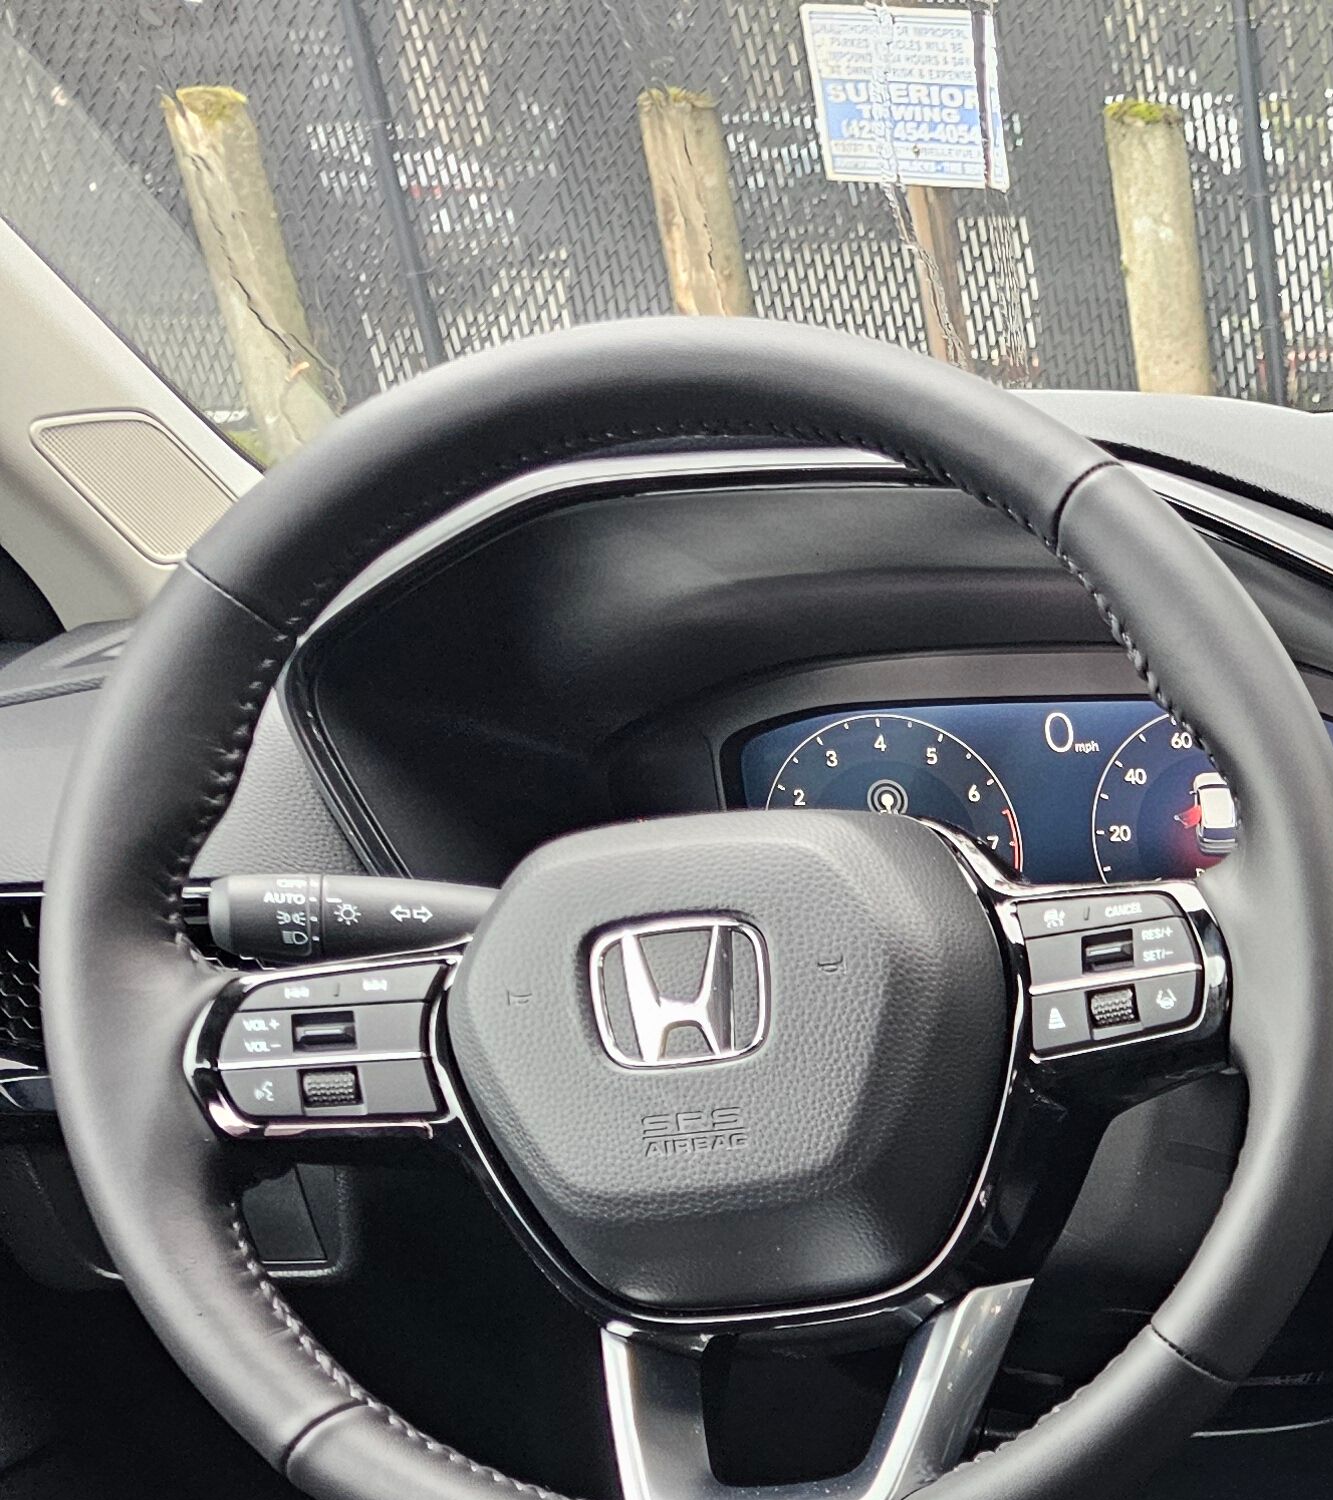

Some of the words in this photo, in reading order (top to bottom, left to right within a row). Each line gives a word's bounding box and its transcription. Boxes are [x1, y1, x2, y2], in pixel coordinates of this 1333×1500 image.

[1044, 712, 1075, 753] 0
[1075, 741, 1100, 755] mph
[1171, 732, 1193, 750] 60
[874, 734, 887, 752] 4
[826, 750, 838, 768] 3
[926, 747, 938, 766] 5
[1124, 768, 1148, 785] 40
[793, 789, 806, 806] 2
[968, 784, 981, 803] 6
[986, 835, 1000, 850] 7
[1109, 825, 1132, 843] 20
[263, 891, 306, 905] AUTO
[1104, 902, 1143, 918] CANCEL
[640, 1106, 743, 1135] SRS
[645, 1133, 748, 1157] AIRBAG
